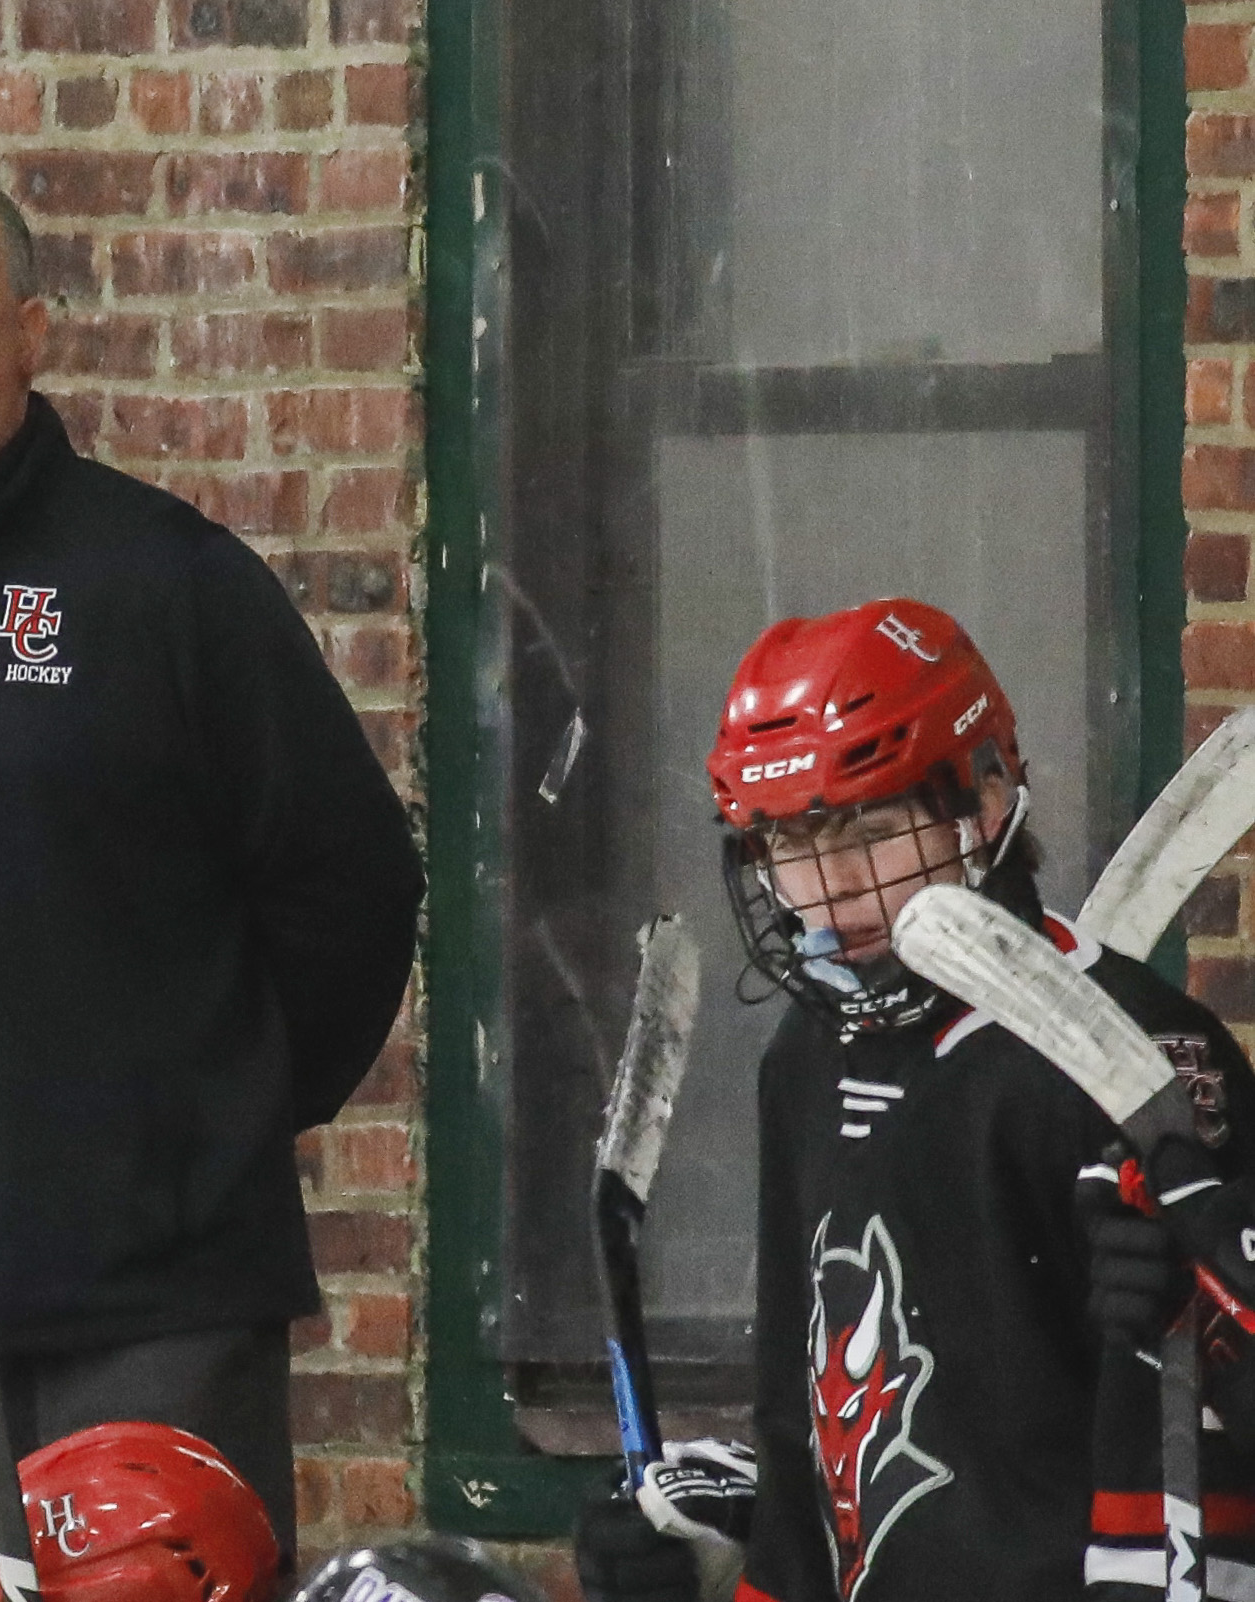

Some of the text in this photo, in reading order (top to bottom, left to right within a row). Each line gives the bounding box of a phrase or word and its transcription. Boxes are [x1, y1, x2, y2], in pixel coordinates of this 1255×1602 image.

[5, 663, 73, 685] HOCKEY
[952, 692, 988, 736] CCM
[741, 752, 816, 783] CCM
[40, 1493, 91, 1558] HC
